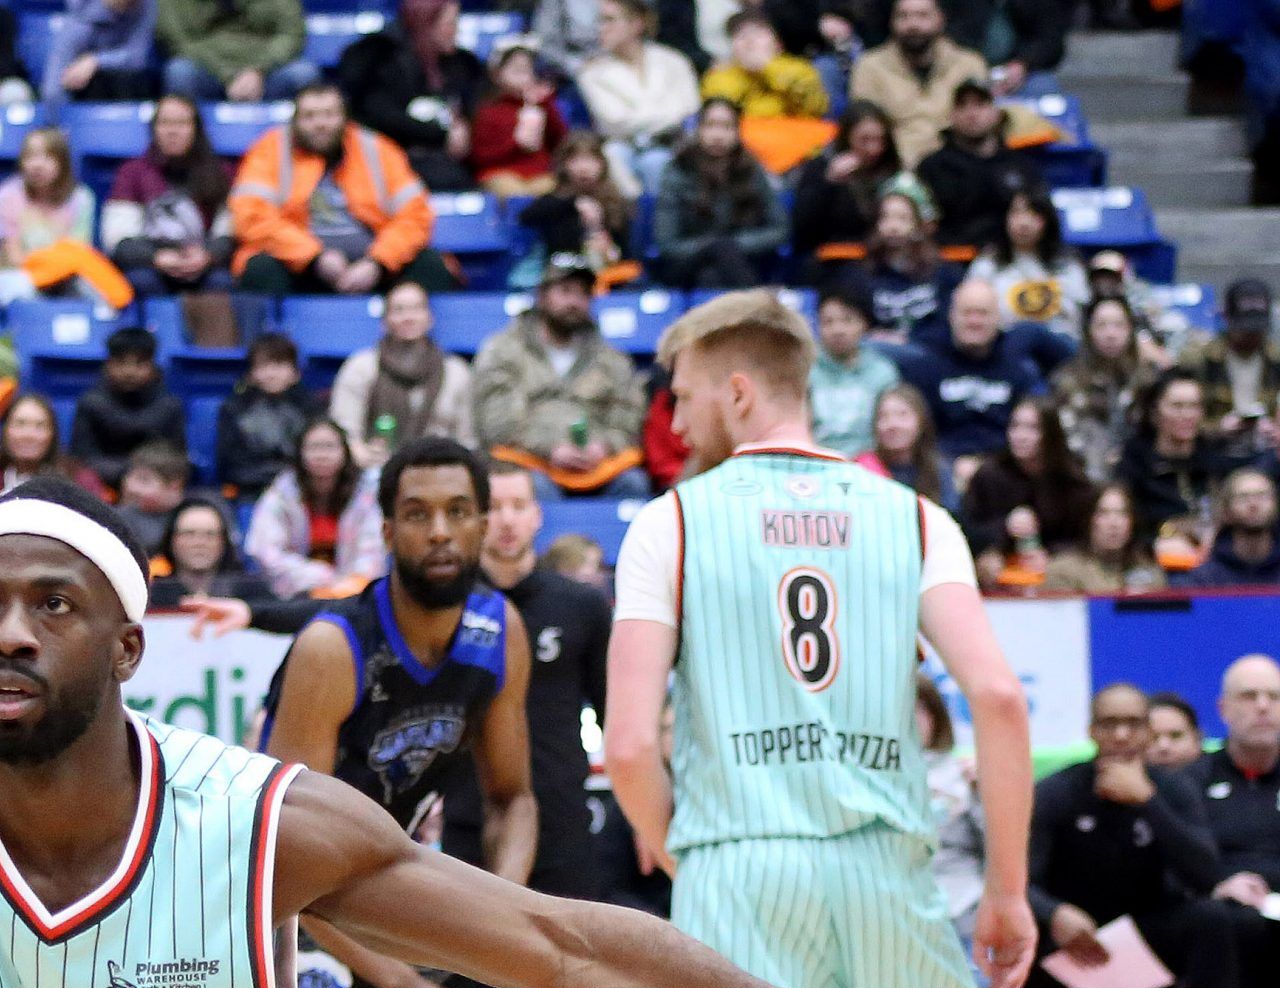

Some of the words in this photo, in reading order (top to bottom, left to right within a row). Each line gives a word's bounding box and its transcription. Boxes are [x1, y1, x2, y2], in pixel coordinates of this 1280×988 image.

[763, 513, 850, 546] KOTOV
[780, 567, 839, 691] 8
[135, 958, 220, 976] Plumbing
[137, 973, 207, 985] WAREHOUSE
